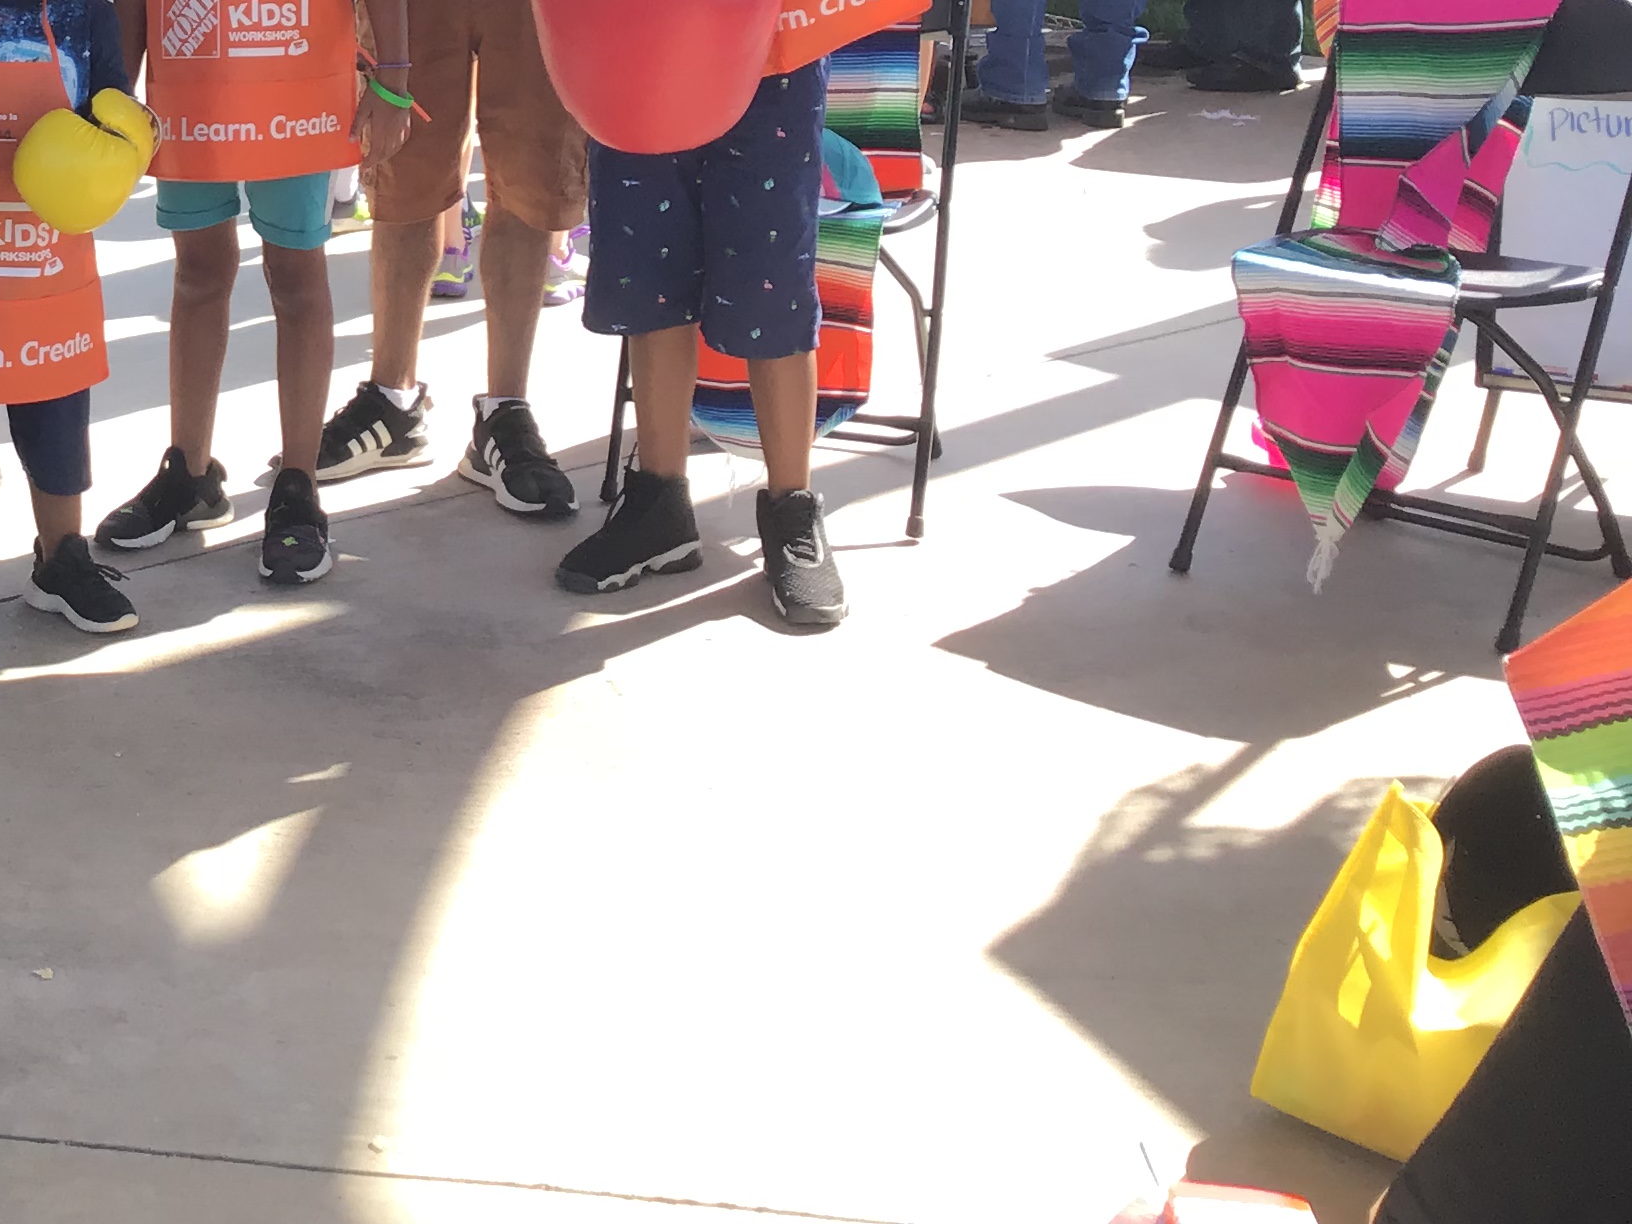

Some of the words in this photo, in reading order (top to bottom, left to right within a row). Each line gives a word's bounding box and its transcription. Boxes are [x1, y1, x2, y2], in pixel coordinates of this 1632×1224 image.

[228, 0, 297, 29] KIDS
[180, 11, 219, 57] DEPOT
[228, 29, 300, 42] WORKSHOPS
[181, 117, 264, 142] Learn.
[270, 111, 341, 140] Create.
[20, 331, 95, 367] Create.
